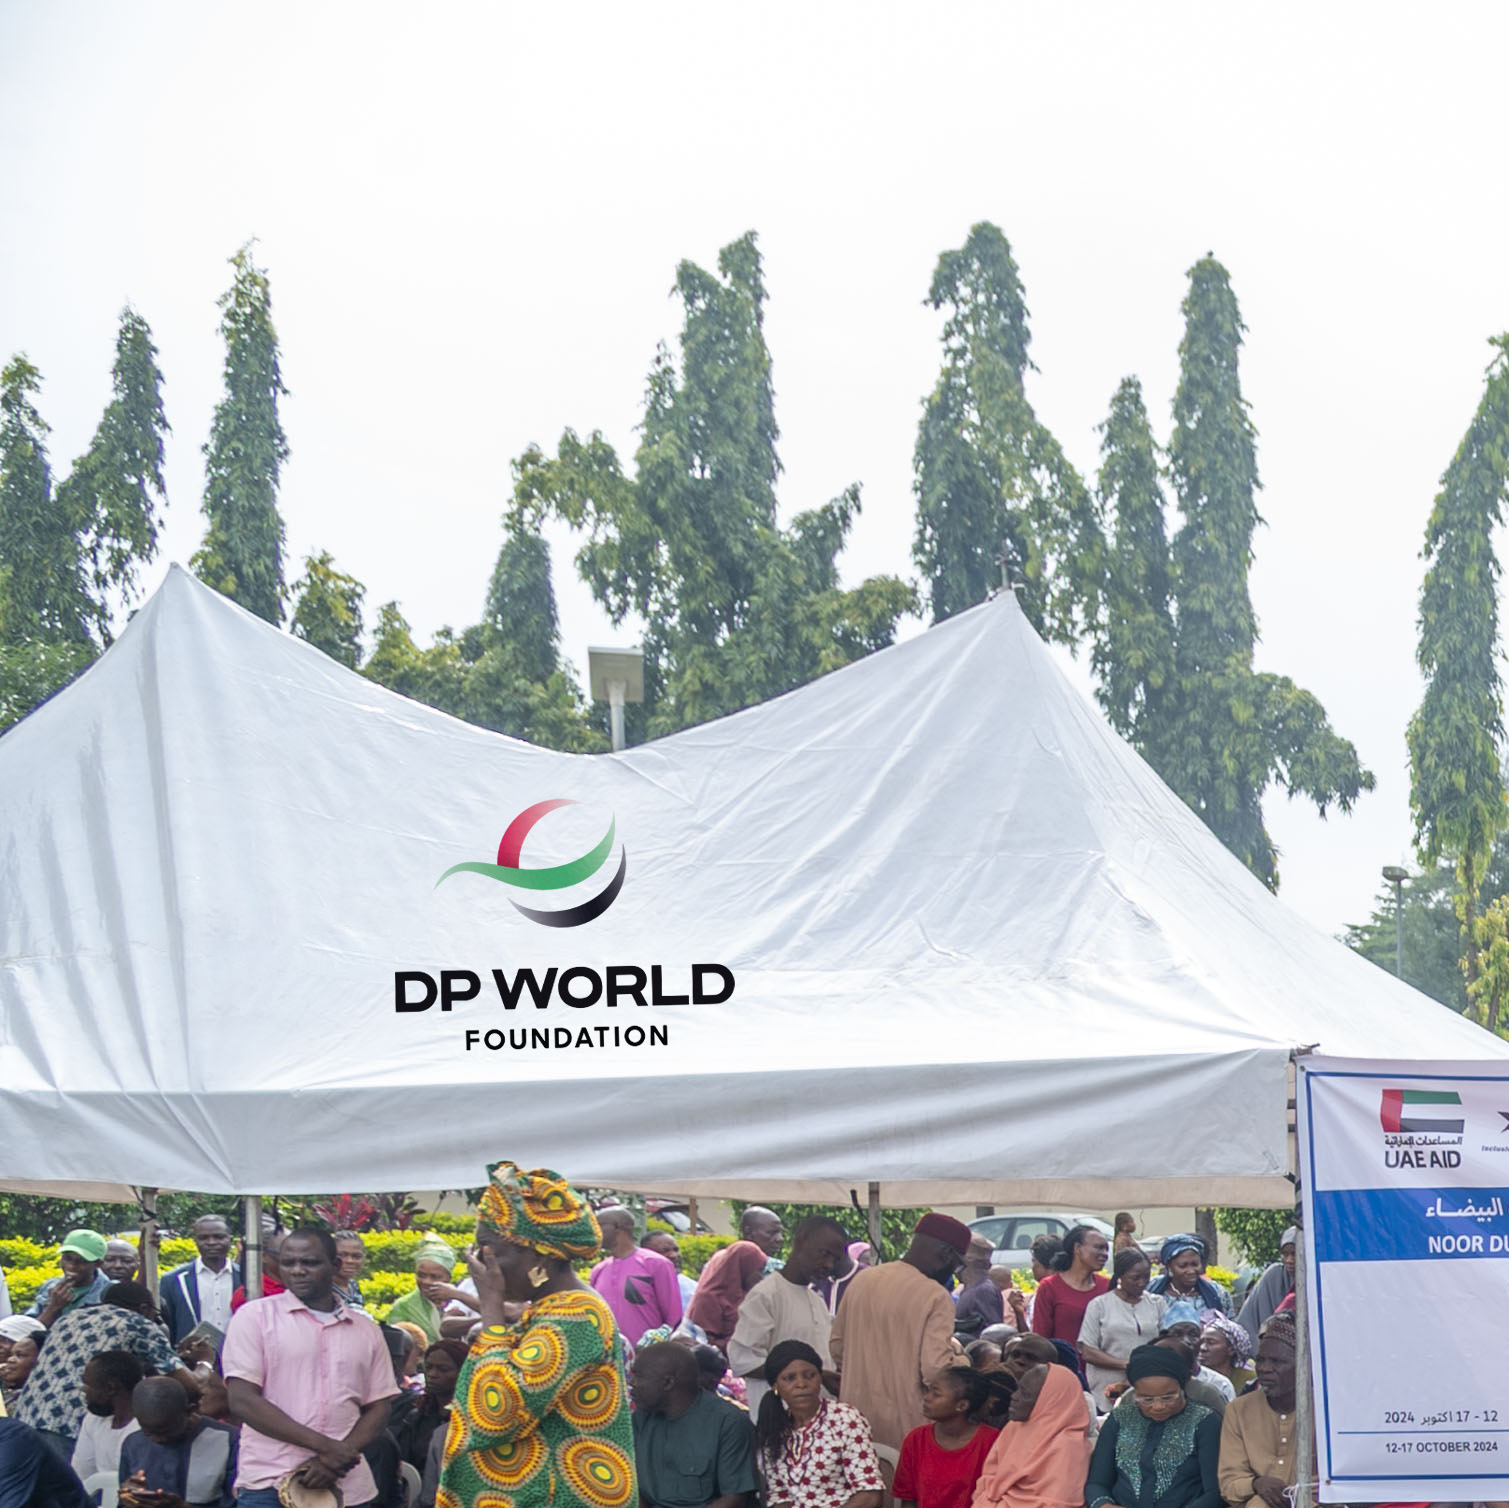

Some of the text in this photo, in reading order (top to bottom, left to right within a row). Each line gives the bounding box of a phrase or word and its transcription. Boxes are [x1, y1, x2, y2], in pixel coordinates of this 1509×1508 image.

[394, 963, 736, 1013] DP WORLD
[465, 1024, 669, 1051] FOUNDATION
[1384, 1150, 1462, 1169] UAE AID
[1426, 1197, 1504, 1223] البيضاء
[1428, 1234, 1484, 1253] NOOR
[1384, 1411, 1415, 1423] 2024
[1456, 1410, 1470, 1423] 17
[1483, 1410, 1498, 1422] 12
[1385, 1440, 1498, 1453] 12-17 OCTOBER 2024
